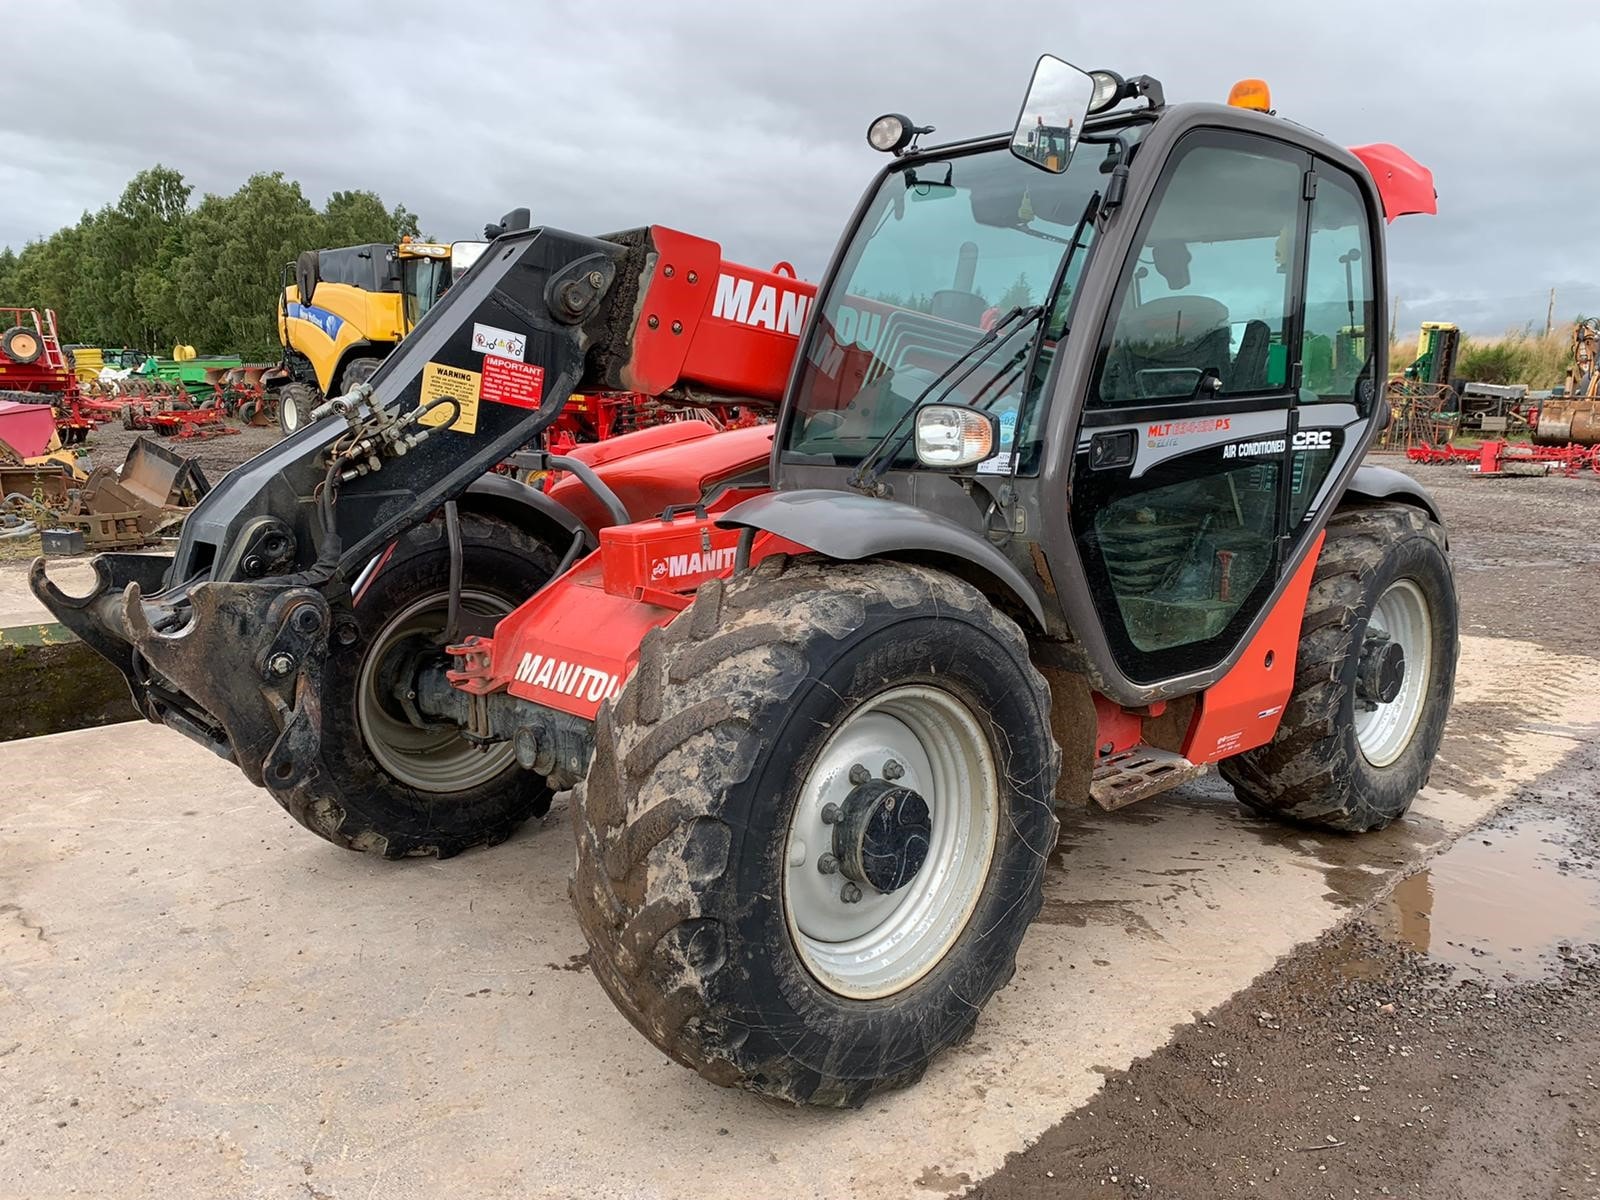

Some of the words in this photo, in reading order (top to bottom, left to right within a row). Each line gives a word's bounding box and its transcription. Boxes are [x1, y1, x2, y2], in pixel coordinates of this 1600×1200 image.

[436, 367, 471, 382] WARNING
[487, 357, 542, 376] IMPORTANT
[1147, 423, 1172, 438] MLT
[1215, 417, 1231, 431] PS
[1292, 431, 1332, 445] CRC
[1222, 444, 1237, 459] AIR
[1238, 440, 1286, 457] CONDITIONED
